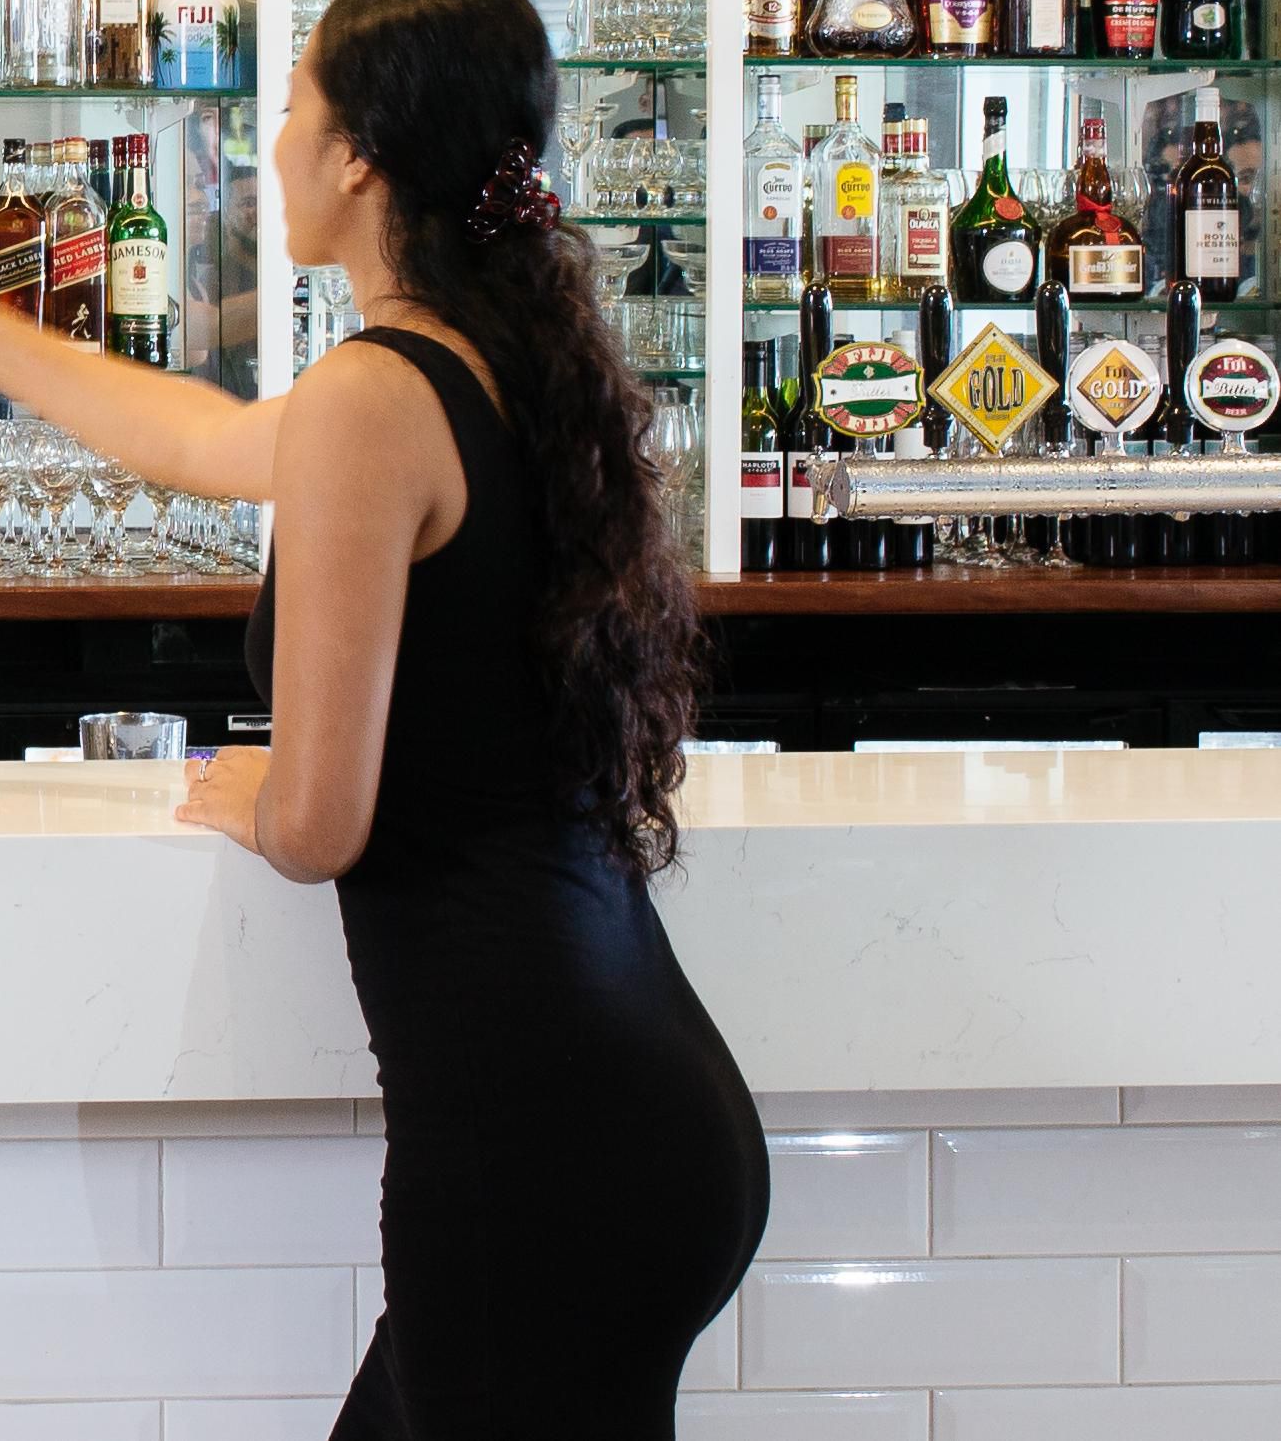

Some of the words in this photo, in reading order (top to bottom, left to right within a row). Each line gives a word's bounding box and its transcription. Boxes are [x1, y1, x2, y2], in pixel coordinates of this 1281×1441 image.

[768, 2, 778, 11] 12
[178, 6, 213, 24] FIJI
[763, 183, 792, 193] Cuervo
[841, 182, 870, 193] Cuervo
[909, 219, 940, 230] OLMECA
[18, 251, 44, 266] LABEL
[53, 254, 73, 266] RED
[74, 243, 105, 260] LABEL
[111, 245, 166, 261] JAMESON
[843, 346, 894, 367] FIJI
[968, 365, 1024, 413] GOLD
[1090, 379, 1140, 399] GOLD
[1214, 381, 1258, 397] Bitter
[1225, 408, 1247, 416] BEER
[848, 412, 896, 433] FIJI
